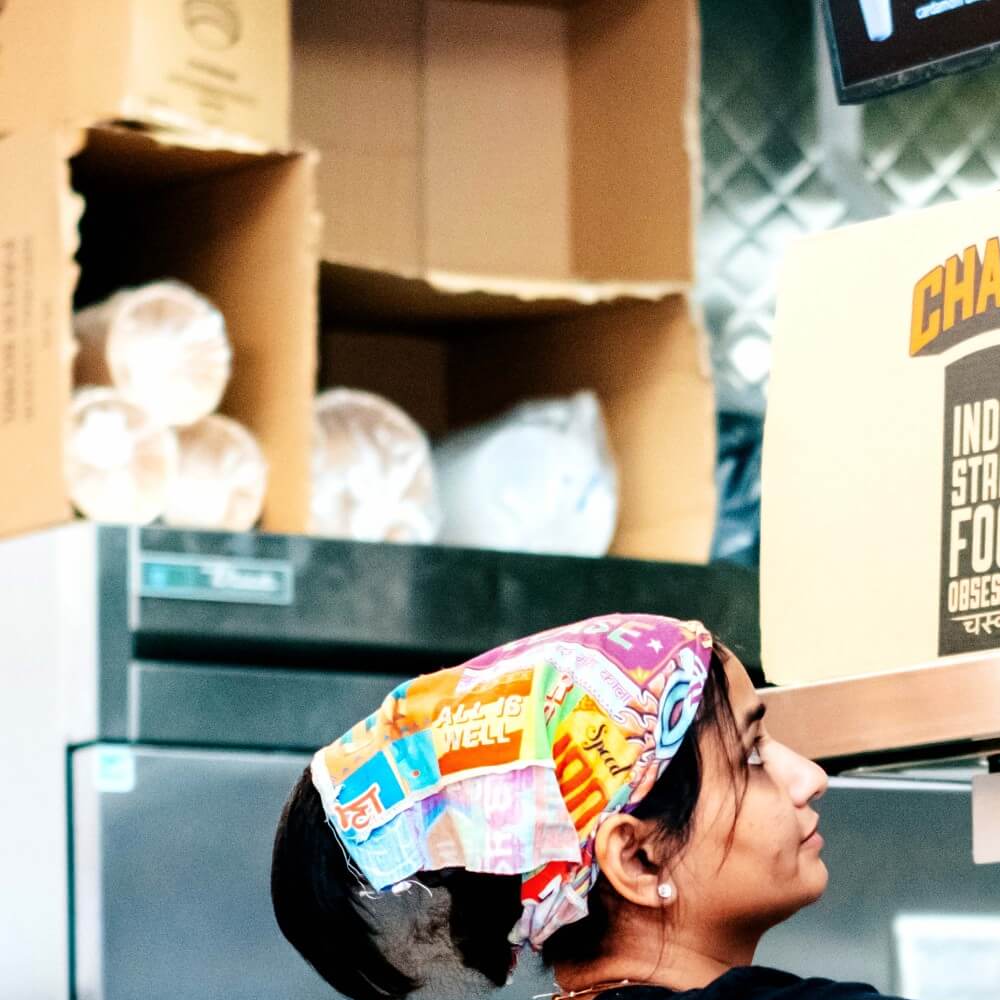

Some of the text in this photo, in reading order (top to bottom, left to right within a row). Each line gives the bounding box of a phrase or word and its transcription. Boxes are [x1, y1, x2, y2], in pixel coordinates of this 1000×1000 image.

[435, 701, 486, 728] ALL
[441, 718, 512, 751] WELL
[582, 723, 634, 777] Speed
